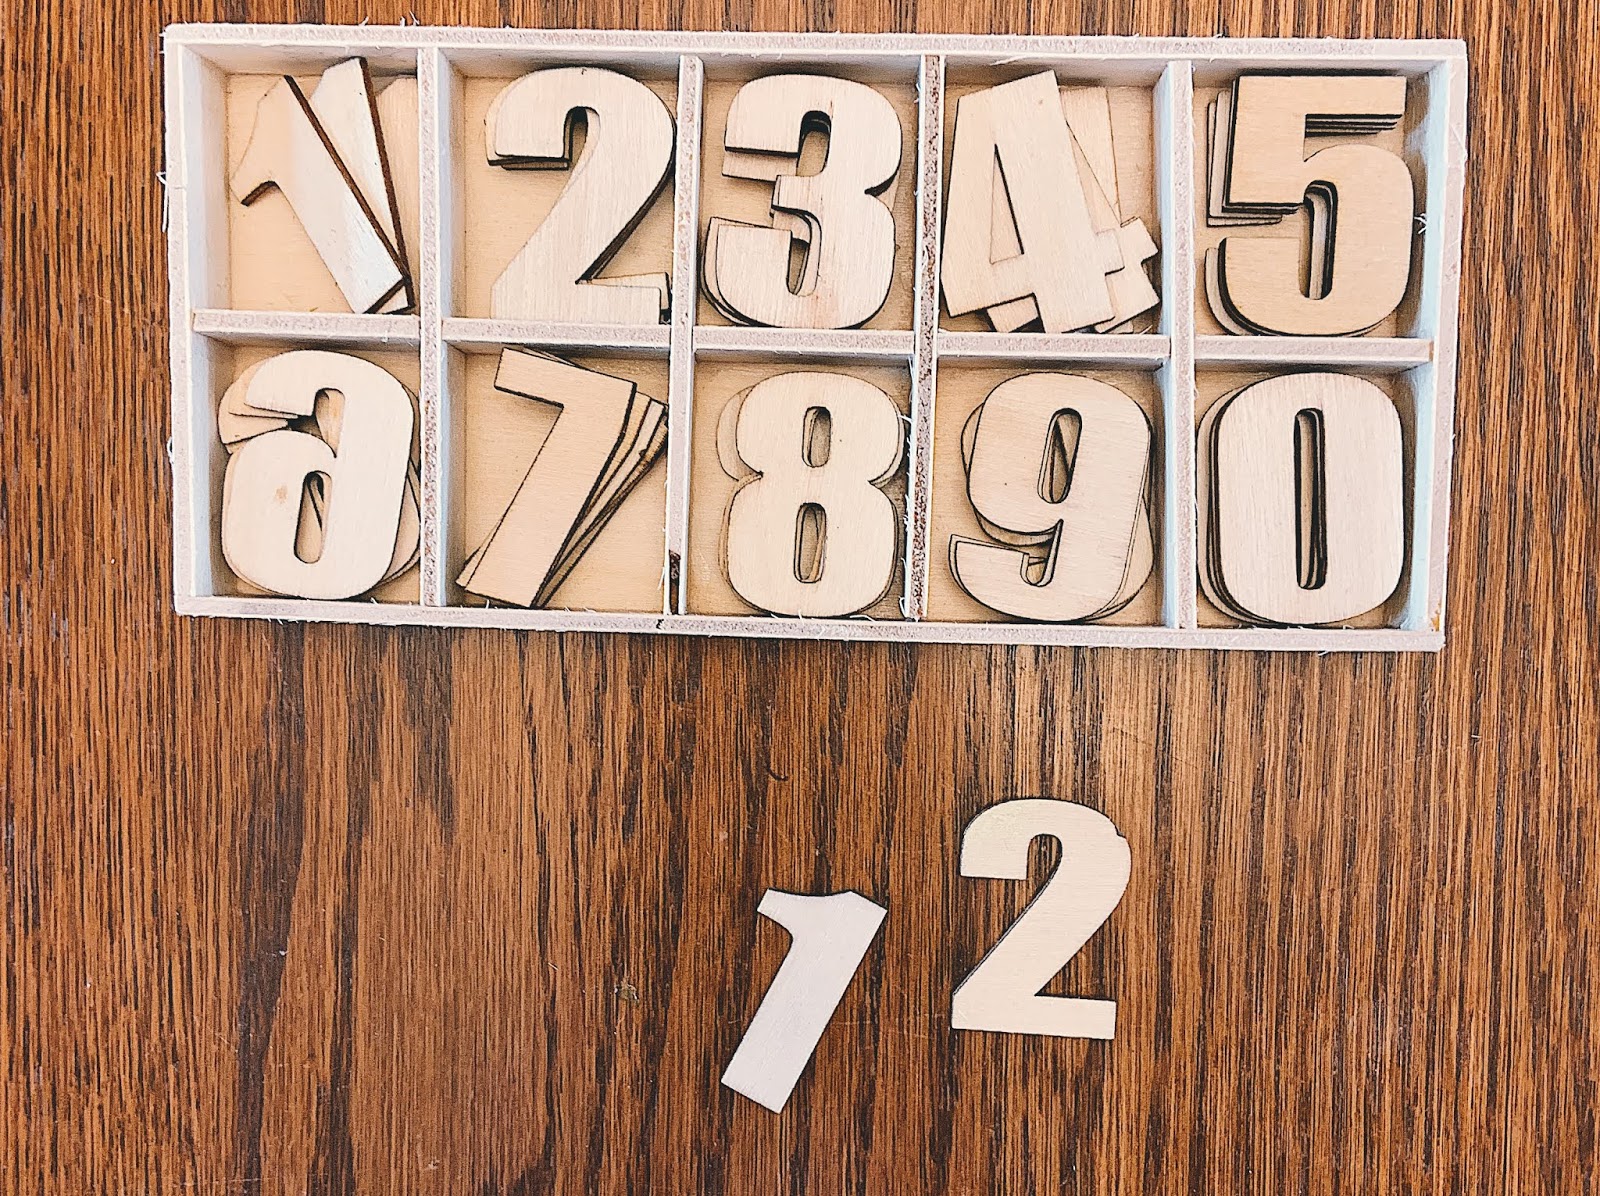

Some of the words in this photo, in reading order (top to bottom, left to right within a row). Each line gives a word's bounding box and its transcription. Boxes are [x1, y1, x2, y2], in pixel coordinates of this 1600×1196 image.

[230, 75, 405, 314] 1
[490, 66, 677, 324] 2
[715, 74, 902, 328] 3
[939, 70, 1124, 333] 4
[1219, 75, 1415, 335] 5
[463, 347, 638, 610] 7
[727, 371, 904, 617] 8
[953, 372, 1152, 621] 9
[1214, 372, 1404, 626] 0
